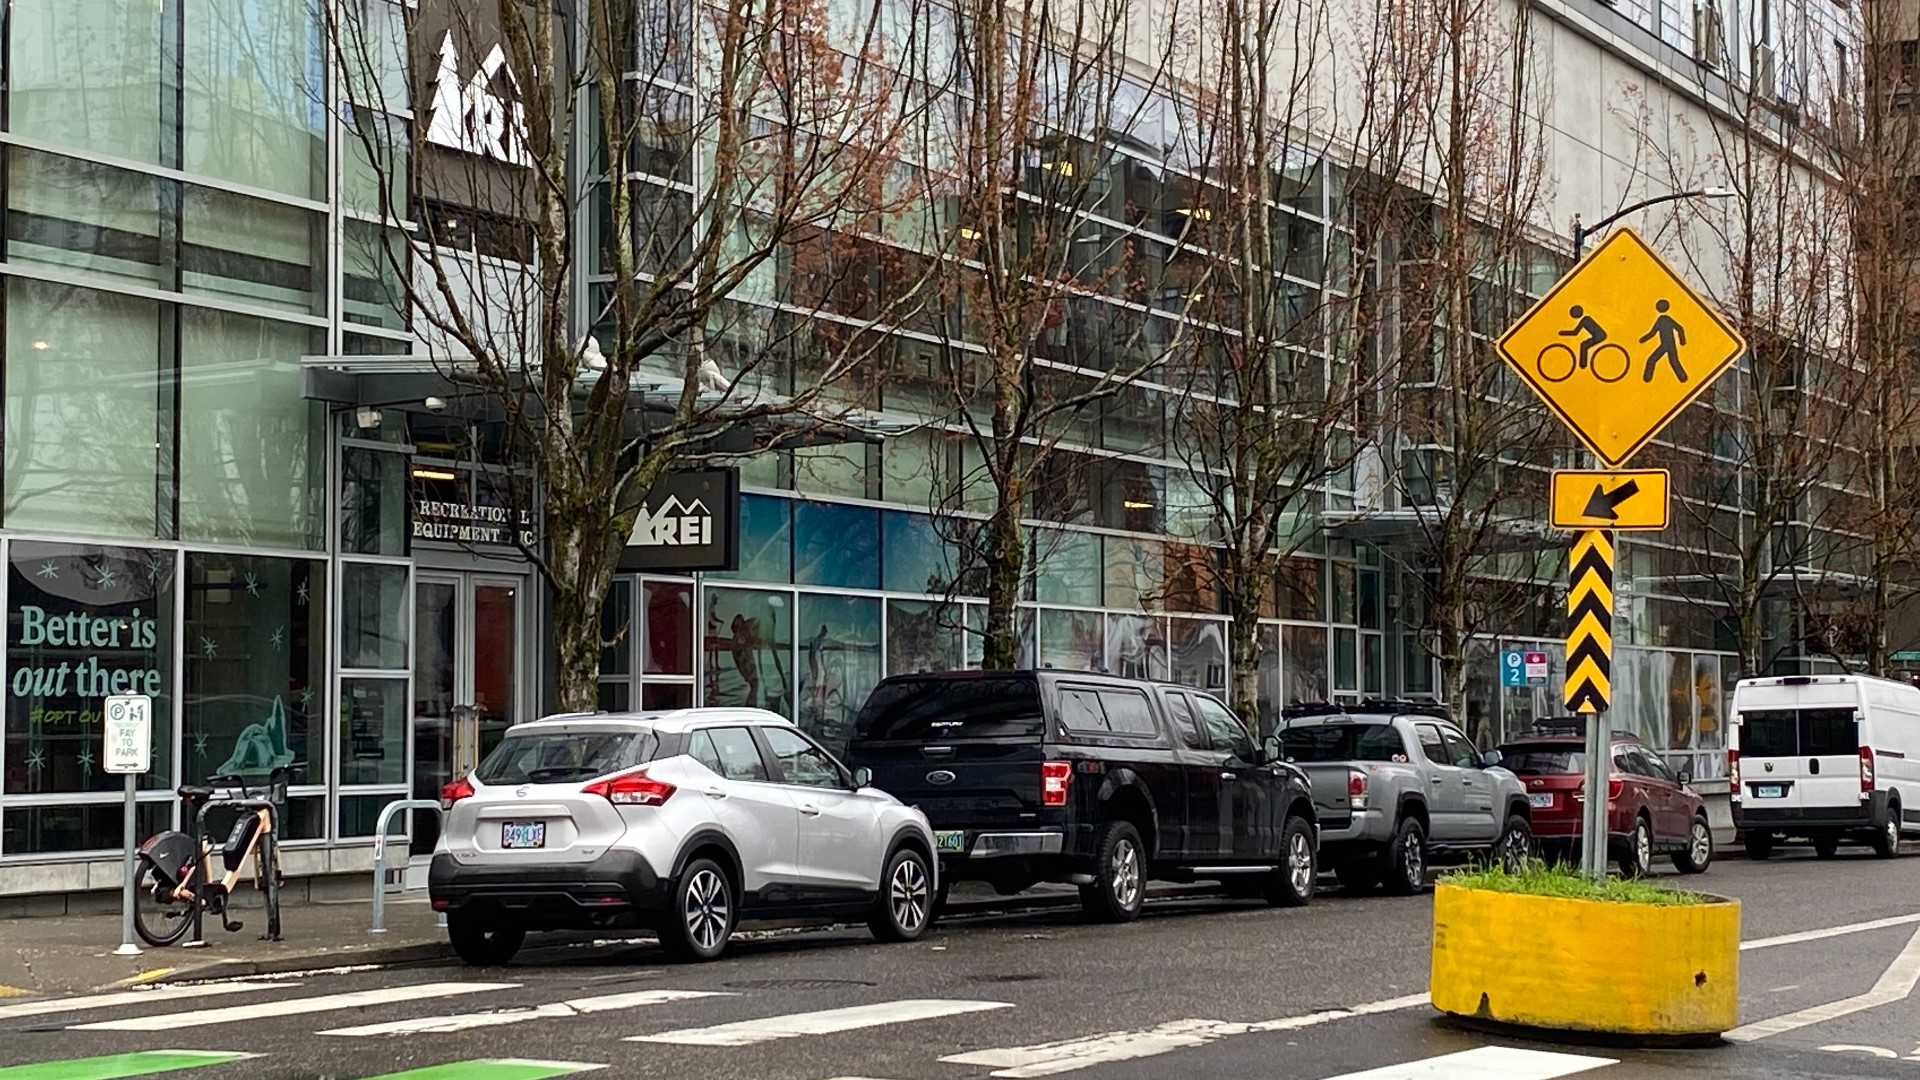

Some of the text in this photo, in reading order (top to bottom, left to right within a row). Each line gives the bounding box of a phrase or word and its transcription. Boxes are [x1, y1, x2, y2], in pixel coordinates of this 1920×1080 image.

[420, 500, 530, 524] RECREATIONL
[413, 521, 500, 542] EQUIPMENT
[20, 605, 156, 648] Better is
[13, 656, 161, 697] out there
[1510, 668, 1520, 682] 2
[119, 728, 136, 738] PAY
[122, 738, 133, 748] TO
[115, 747, 138, 757] PARK
